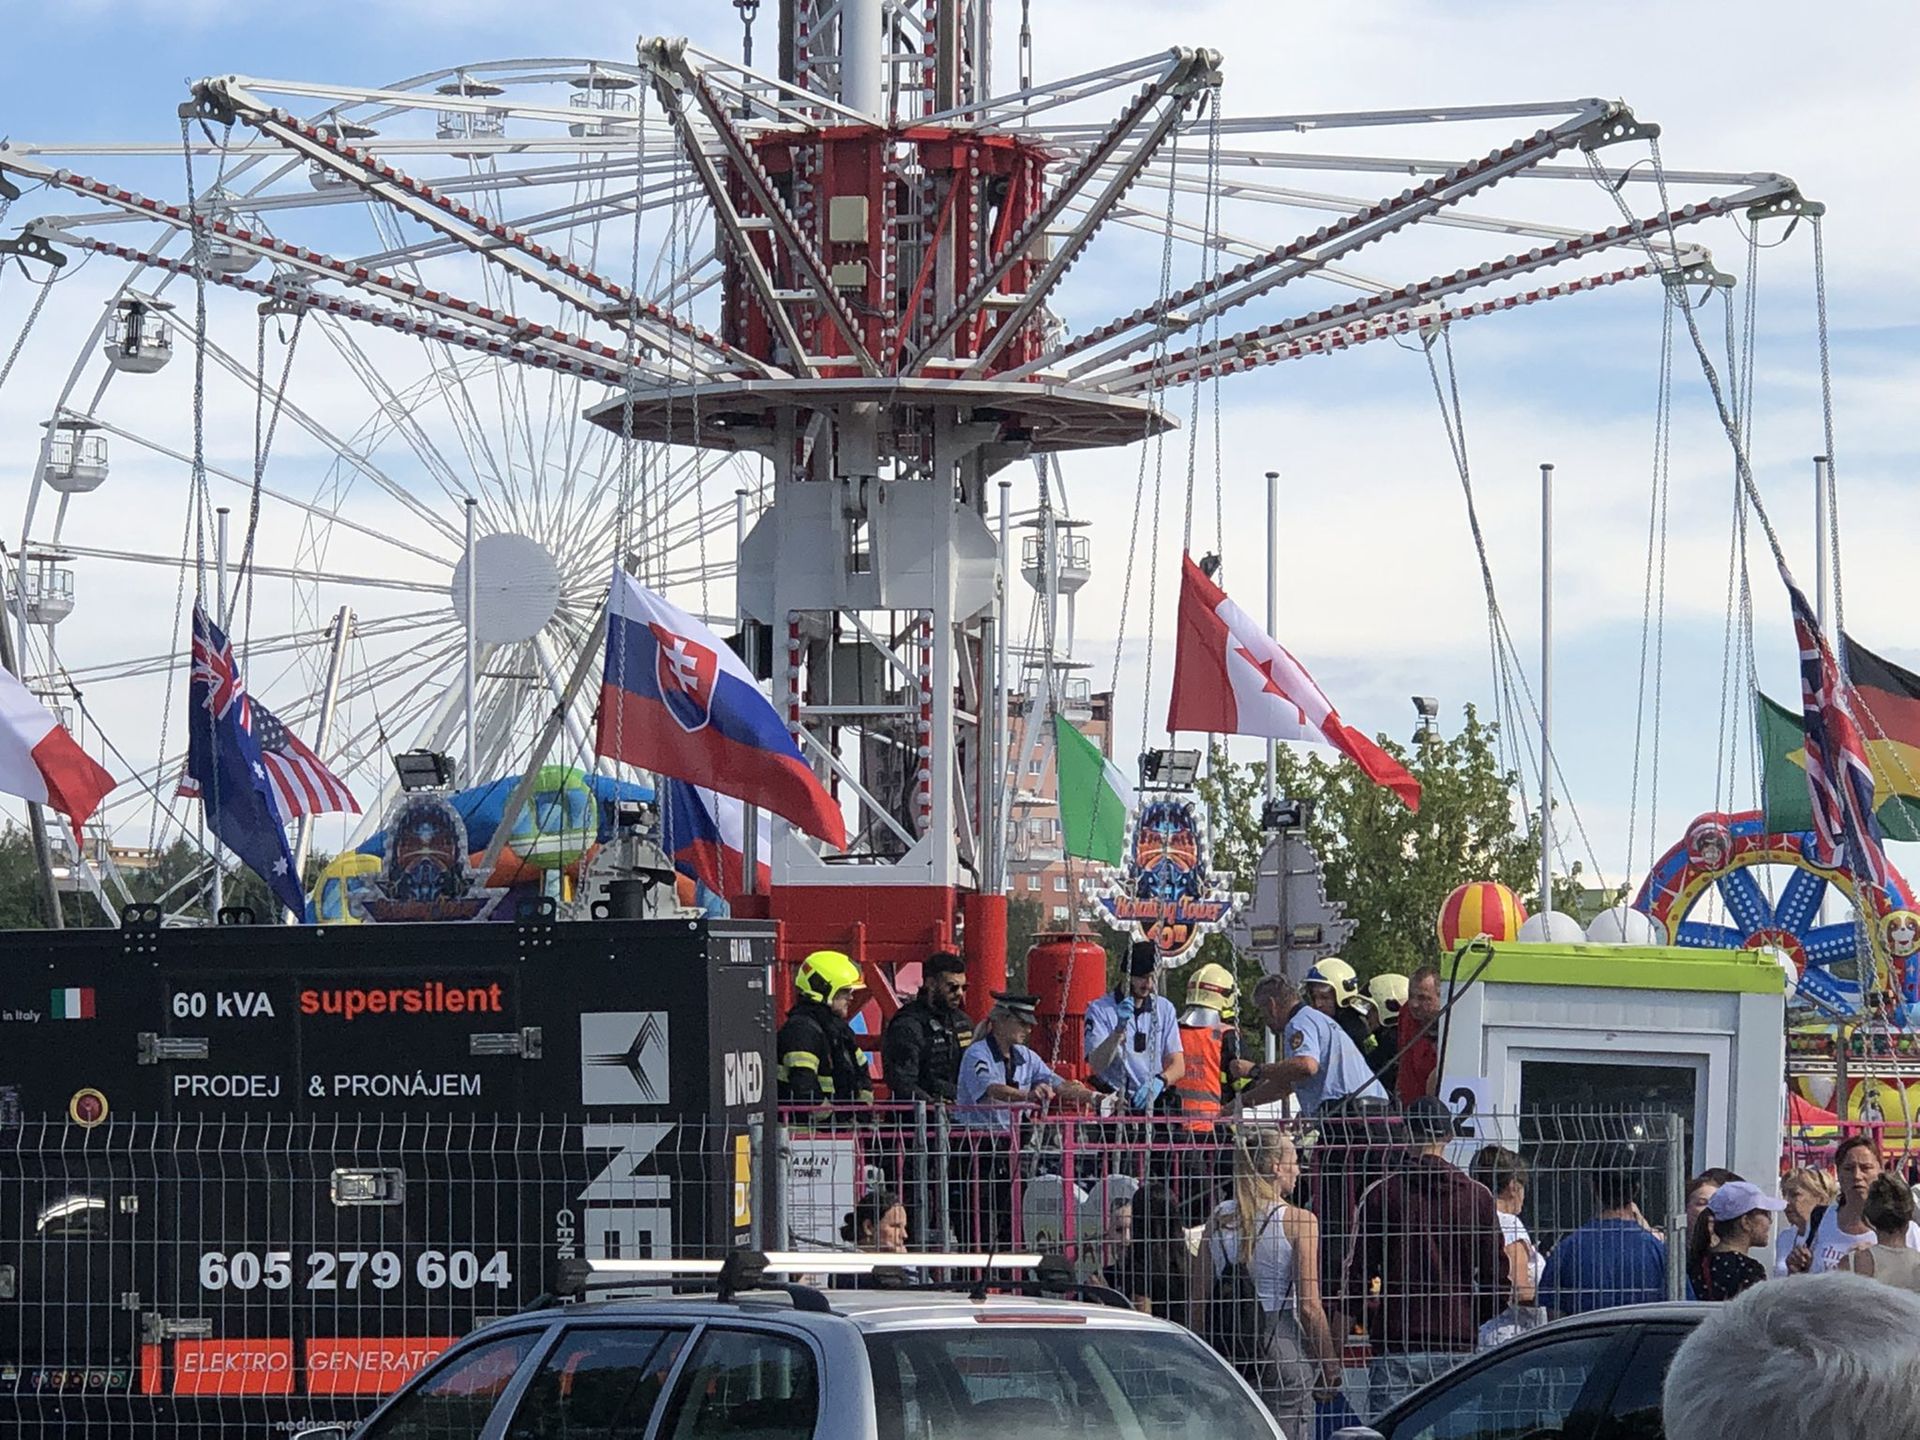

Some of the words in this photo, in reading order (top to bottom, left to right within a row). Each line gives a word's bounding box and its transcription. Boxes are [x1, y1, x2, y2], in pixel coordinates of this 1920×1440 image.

[173, 993, 207, 1018] 60
[217, 992, 275, 1018] kVA
[300, 982, 503, 1020] supersilent
[2, 1010, 13, 1021] in
[15, 1010, 41, 1024] Italy
[174, 1075, 280, 1097] PRODEJ
[308, 1075, 325, 1097] &
[334, 1069, 482, 1097] PRONÁJEM
[1449, 1087, 1475, 1138] 2
[200, 1252, 291, 1289] 605
[307, 1252, 401, 1289] 279
[416, 1251, 512, 1288] 604
[184, 1353, 288, 1372] ELEKTRO
